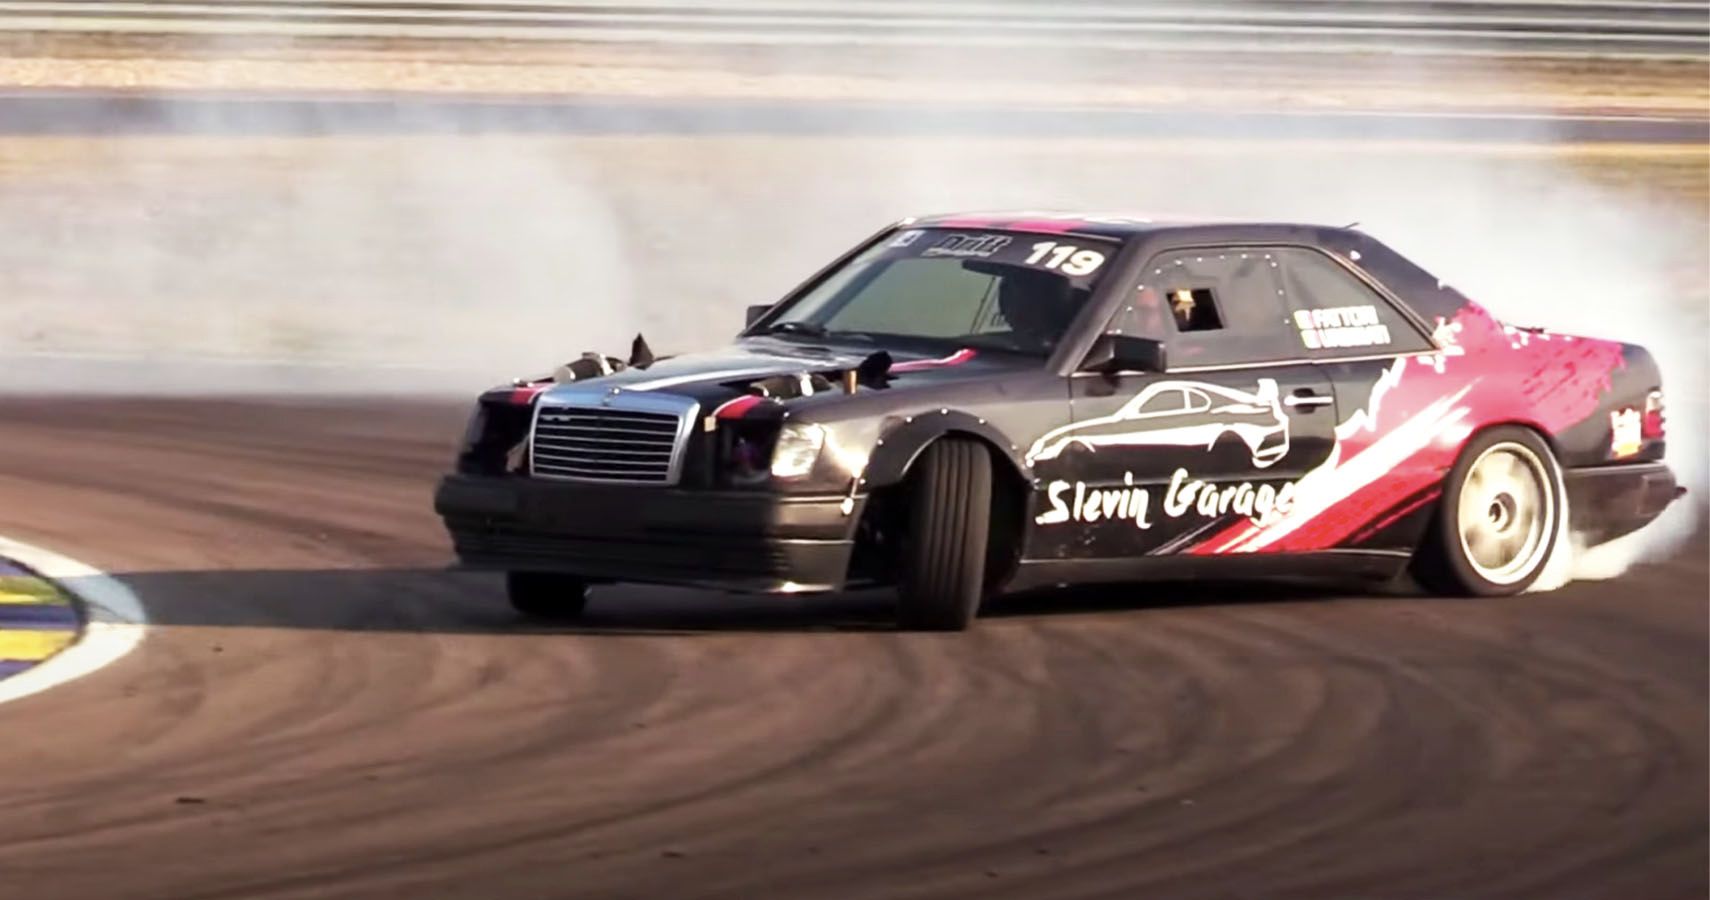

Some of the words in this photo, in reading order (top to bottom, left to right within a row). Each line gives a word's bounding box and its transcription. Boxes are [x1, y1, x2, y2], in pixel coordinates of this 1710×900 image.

[1025, 241, 1105, 276] 119
[1035, 471, 1152, 529] Slevin
[1163, 467, 1297, 529] Garage
